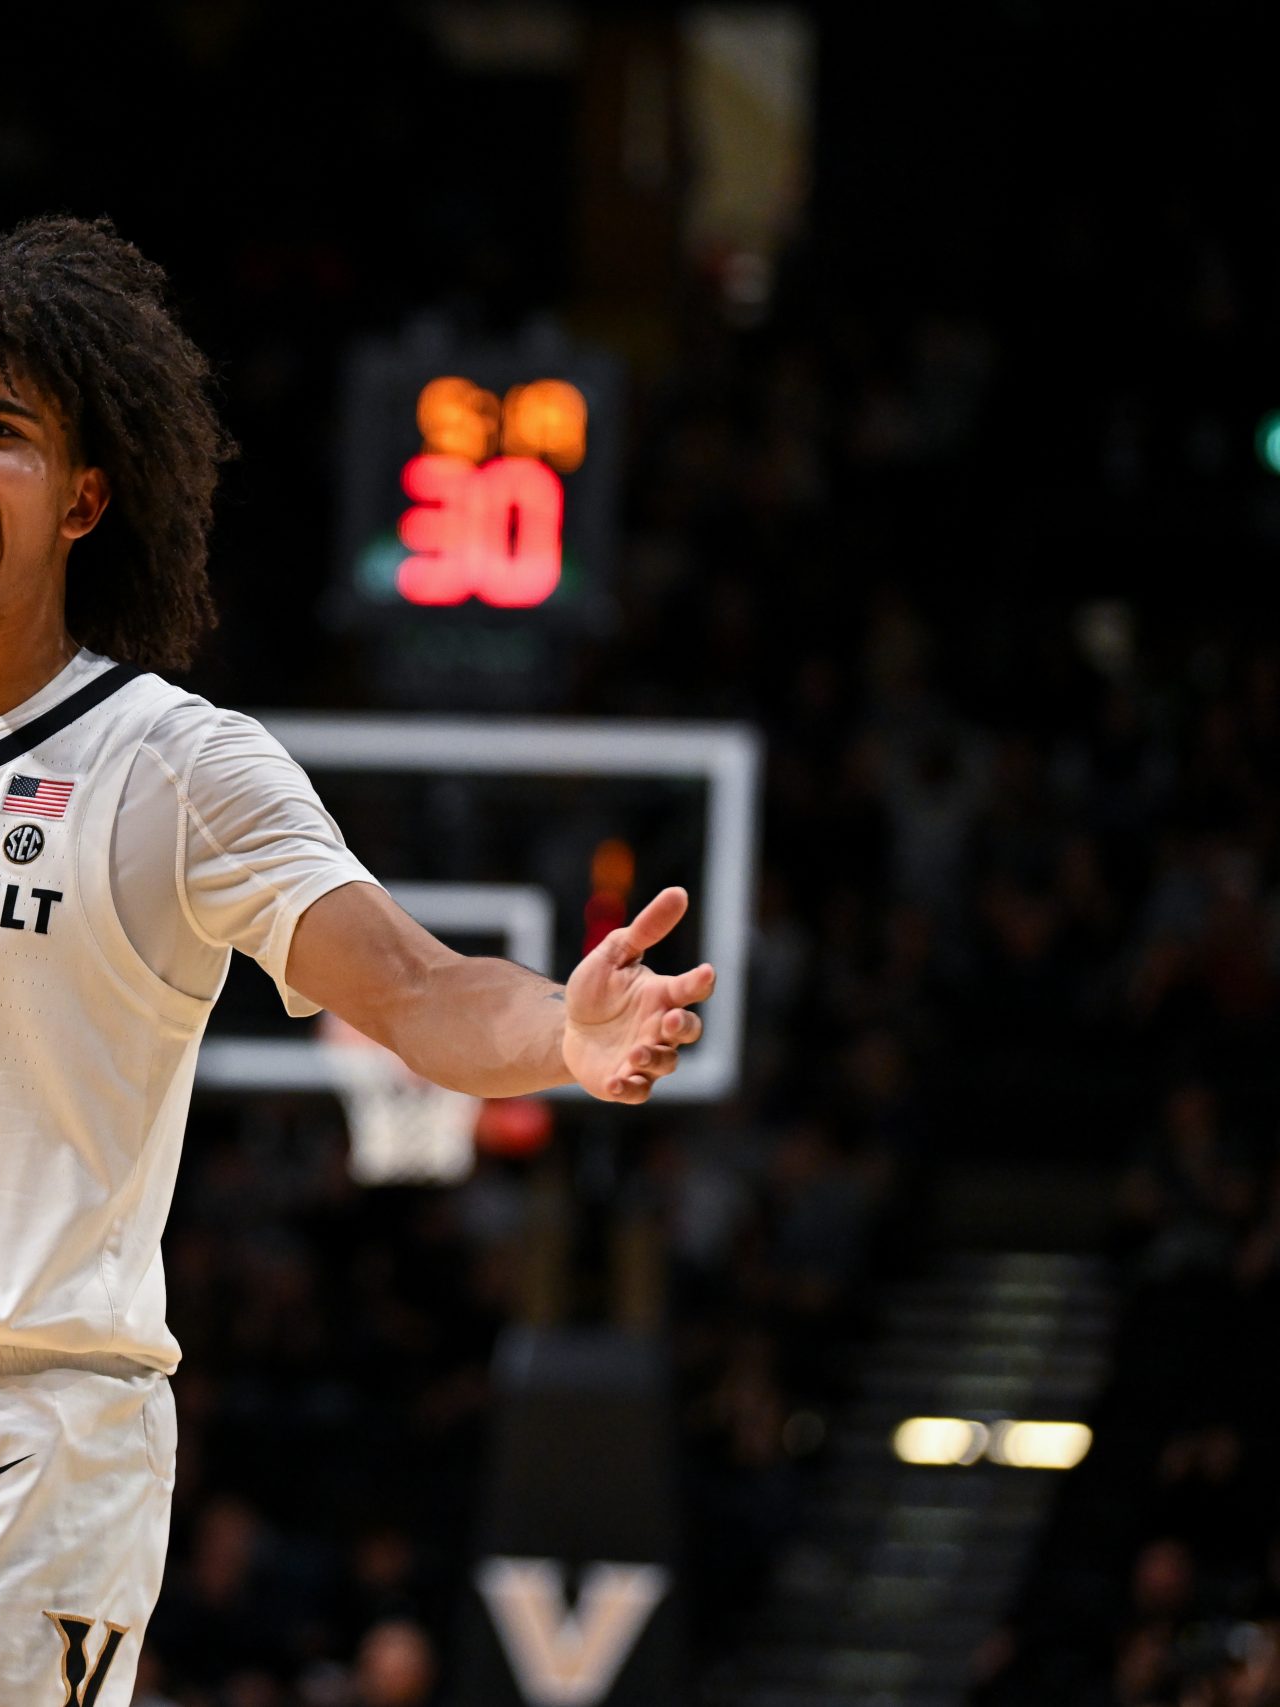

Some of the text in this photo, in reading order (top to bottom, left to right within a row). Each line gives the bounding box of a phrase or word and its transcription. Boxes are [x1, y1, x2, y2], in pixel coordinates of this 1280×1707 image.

[396, 453, 564, 608] 30
[6, 826, 42, 861] SEC
[476, 1556, 670, 1707] V
